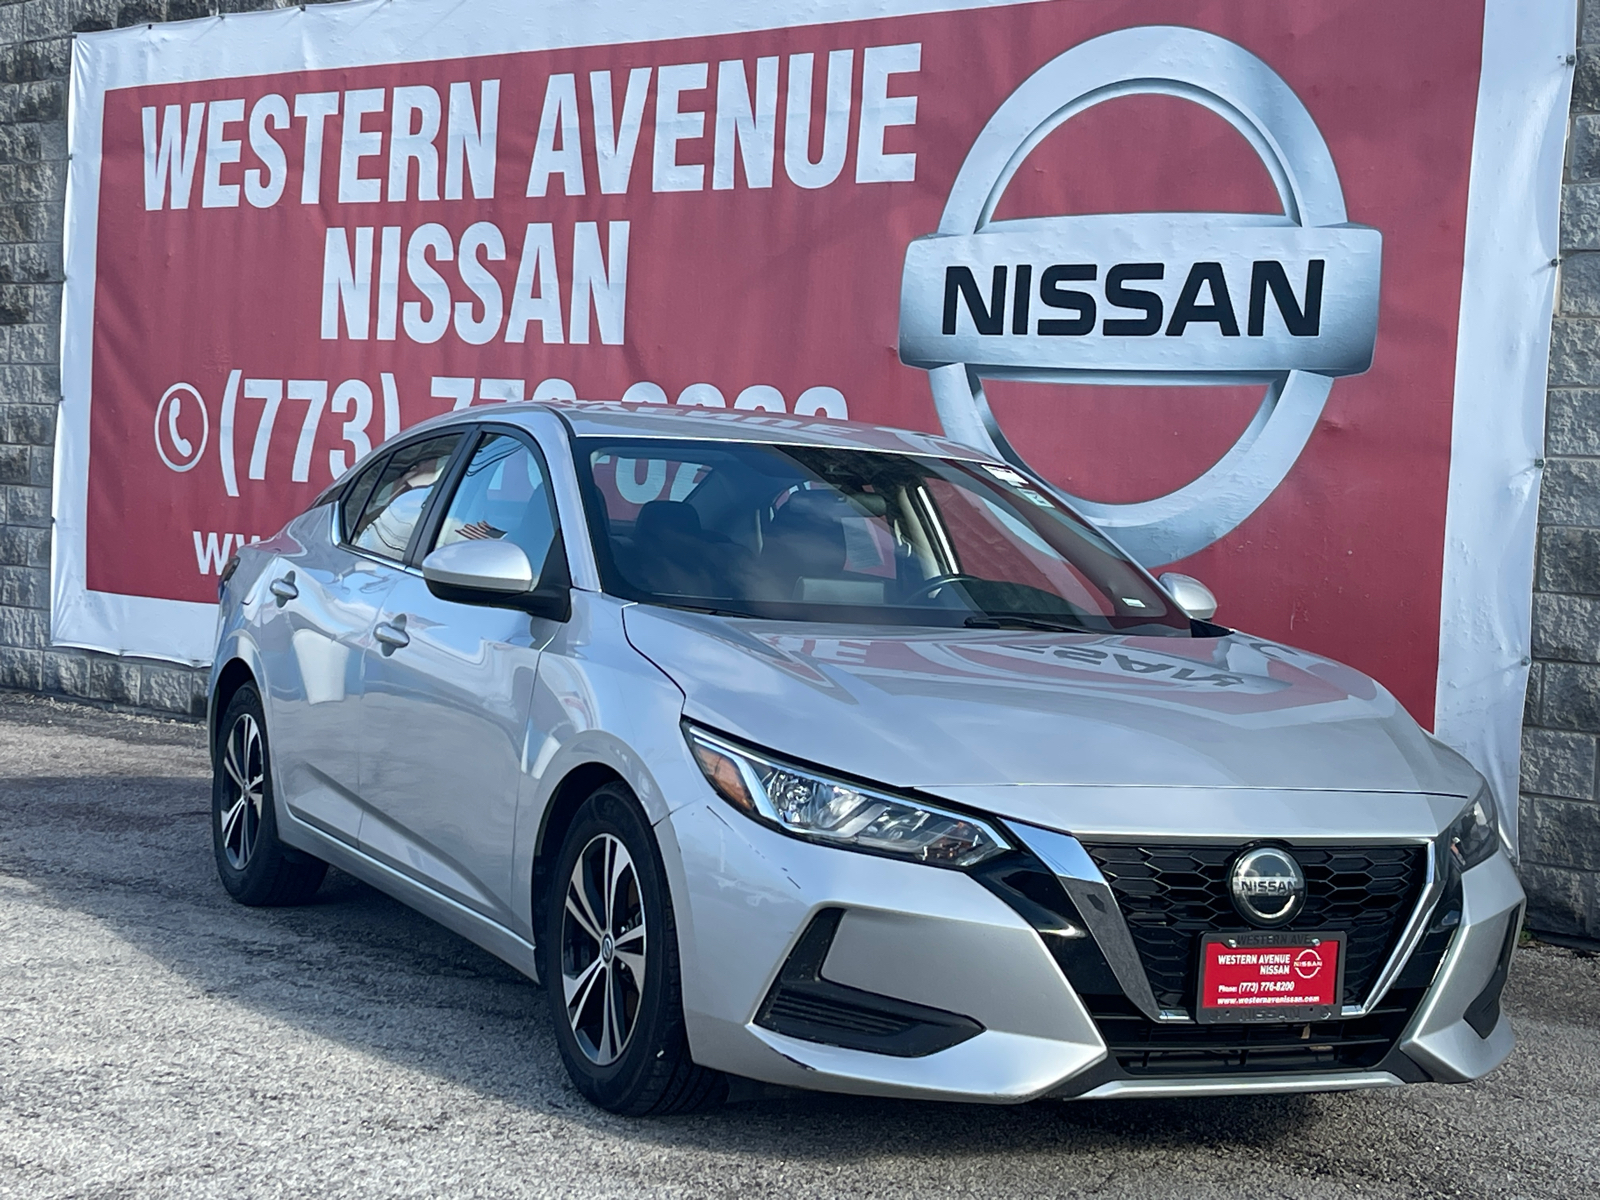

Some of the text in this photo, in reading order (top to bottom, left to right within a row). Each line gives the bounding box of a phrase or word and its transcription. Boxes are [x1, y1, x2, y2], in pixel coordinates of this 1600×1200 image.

[141, 42, 922, 211] WESTERN AVENUE
[320, 220, 631, 346] NISSAN
[942, 258, 1325, 337] NISSAN
[219, 369, 401, 497] (773)
[1241, 879, 1296, 893] NISSAN
[1237, 933, 1288, 946] WESTERN
[1218, 953, 1291, 965] WESTERN AVENUE
[1260, 965, 1290, 975] NISSAN
[1218, 981, 1295, 994] Phone: (773) 776-8200
[1217, 995, 1320, 1005] www.westernavenissan.com
[1242, 1007, 1300, 1021] NISSAN
